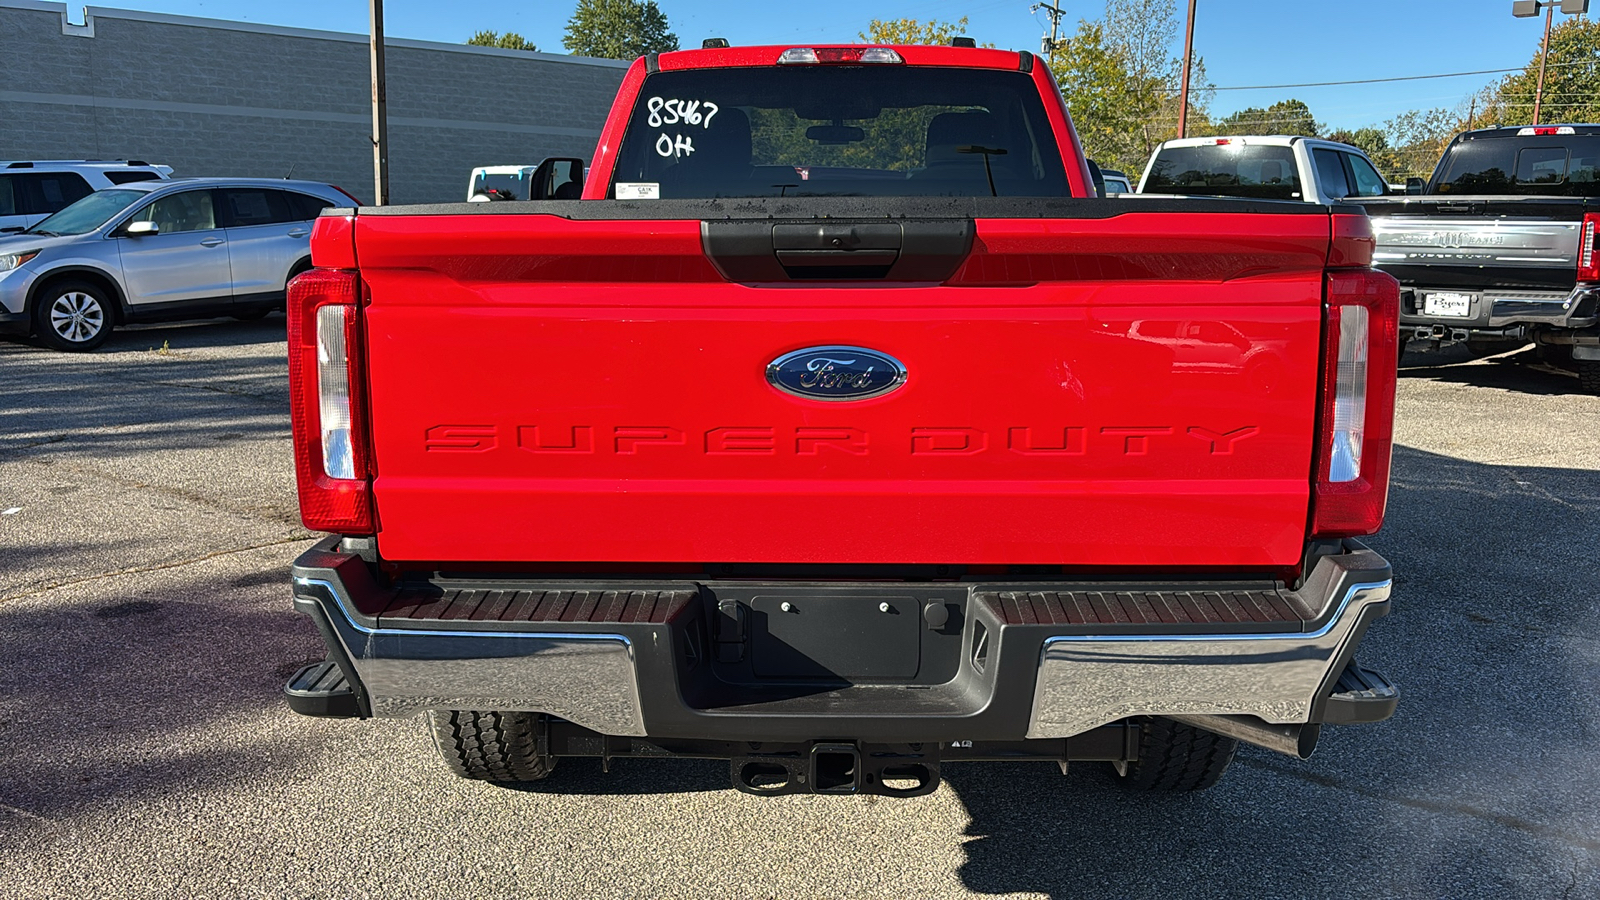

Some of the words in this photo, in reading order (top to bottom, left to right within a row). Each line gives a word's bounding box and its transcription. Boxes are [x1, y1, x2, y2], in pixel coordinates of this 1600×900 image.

[648, 97, 718, 129] 85467
[656, 133, 695, 157] OH
[800, 357, 874, 389] Ford
[425, 424, 870, 456] SUPER
[910, 426, 1260, 456] DUTY
